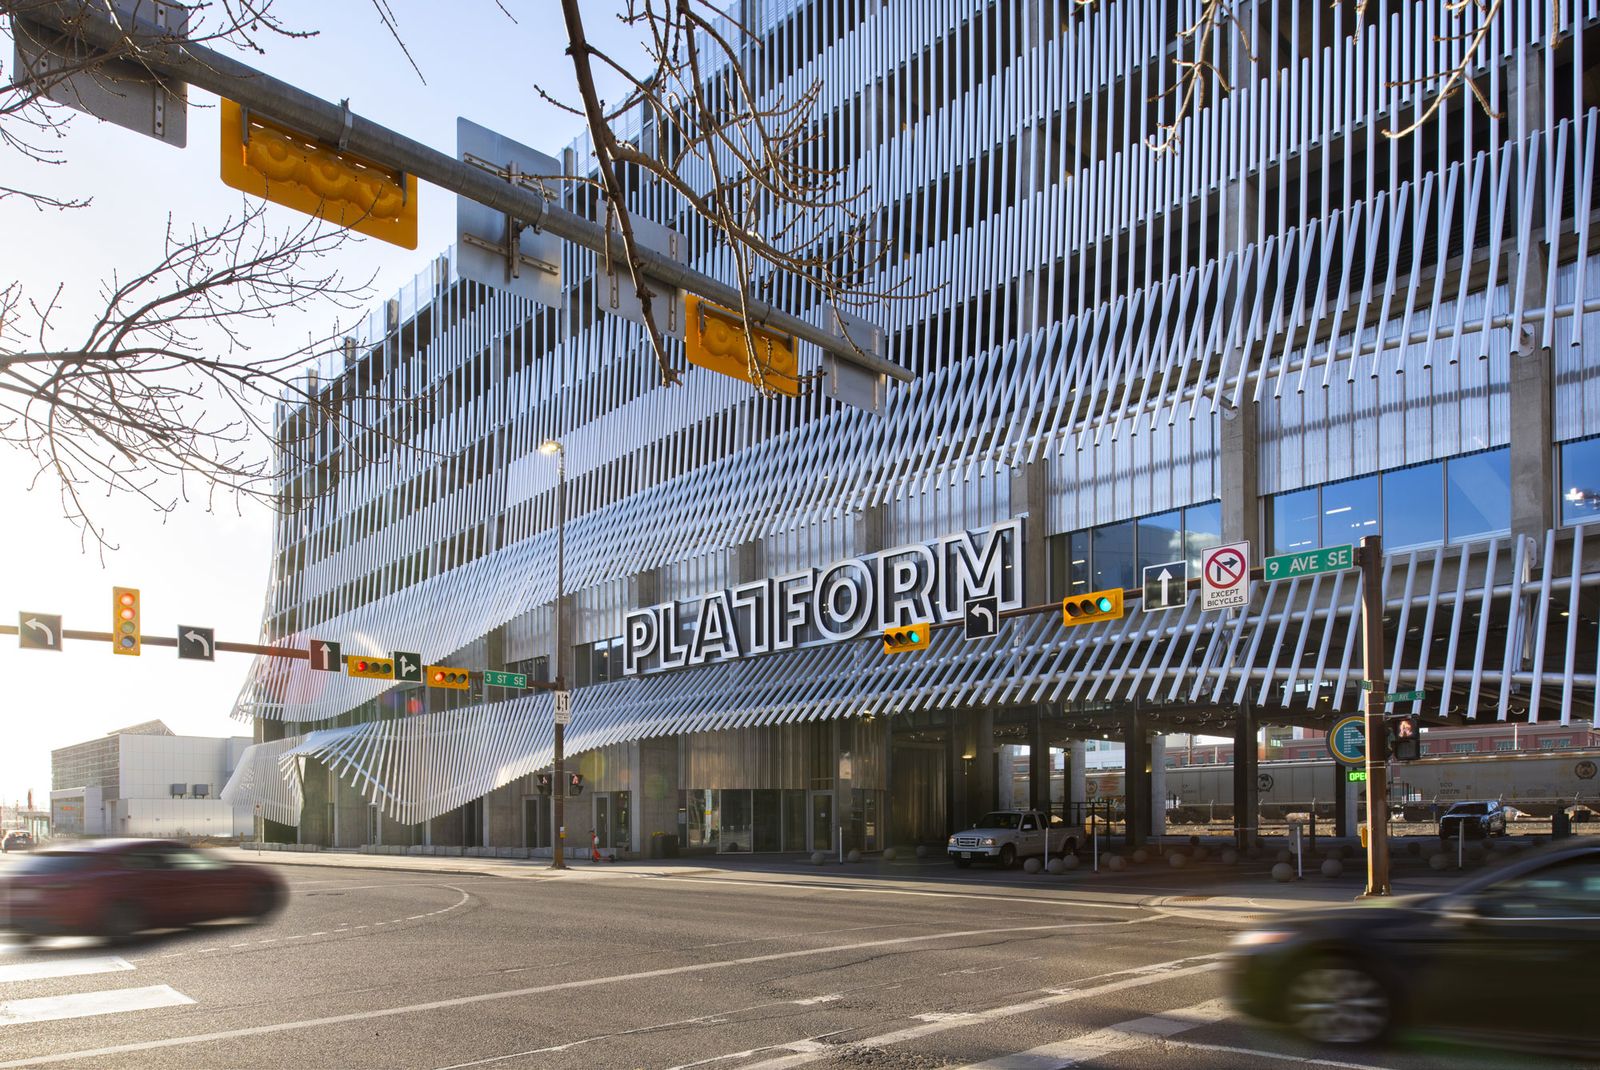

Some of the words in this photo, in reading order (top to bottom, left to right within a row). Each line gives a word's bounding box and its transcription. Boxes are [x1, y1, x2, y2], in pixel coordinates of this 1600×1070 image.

[1269, 562, 1280, 576] 9
[1289, 555, 1319, 573] AVE
[1327, 550, 1348, 566] SE
[623, 517, 1026, 675] PLATFORM
[1210, 588, 1240, 599] EXCEPT
[1207, 596, 1244, 607] BICYCLES
[486, 673, 492, 682] 3
[497, 675, 507, 684] ST
[513, 676, 524, 686] SE
[1349, 772, 1367, 782] OPE
